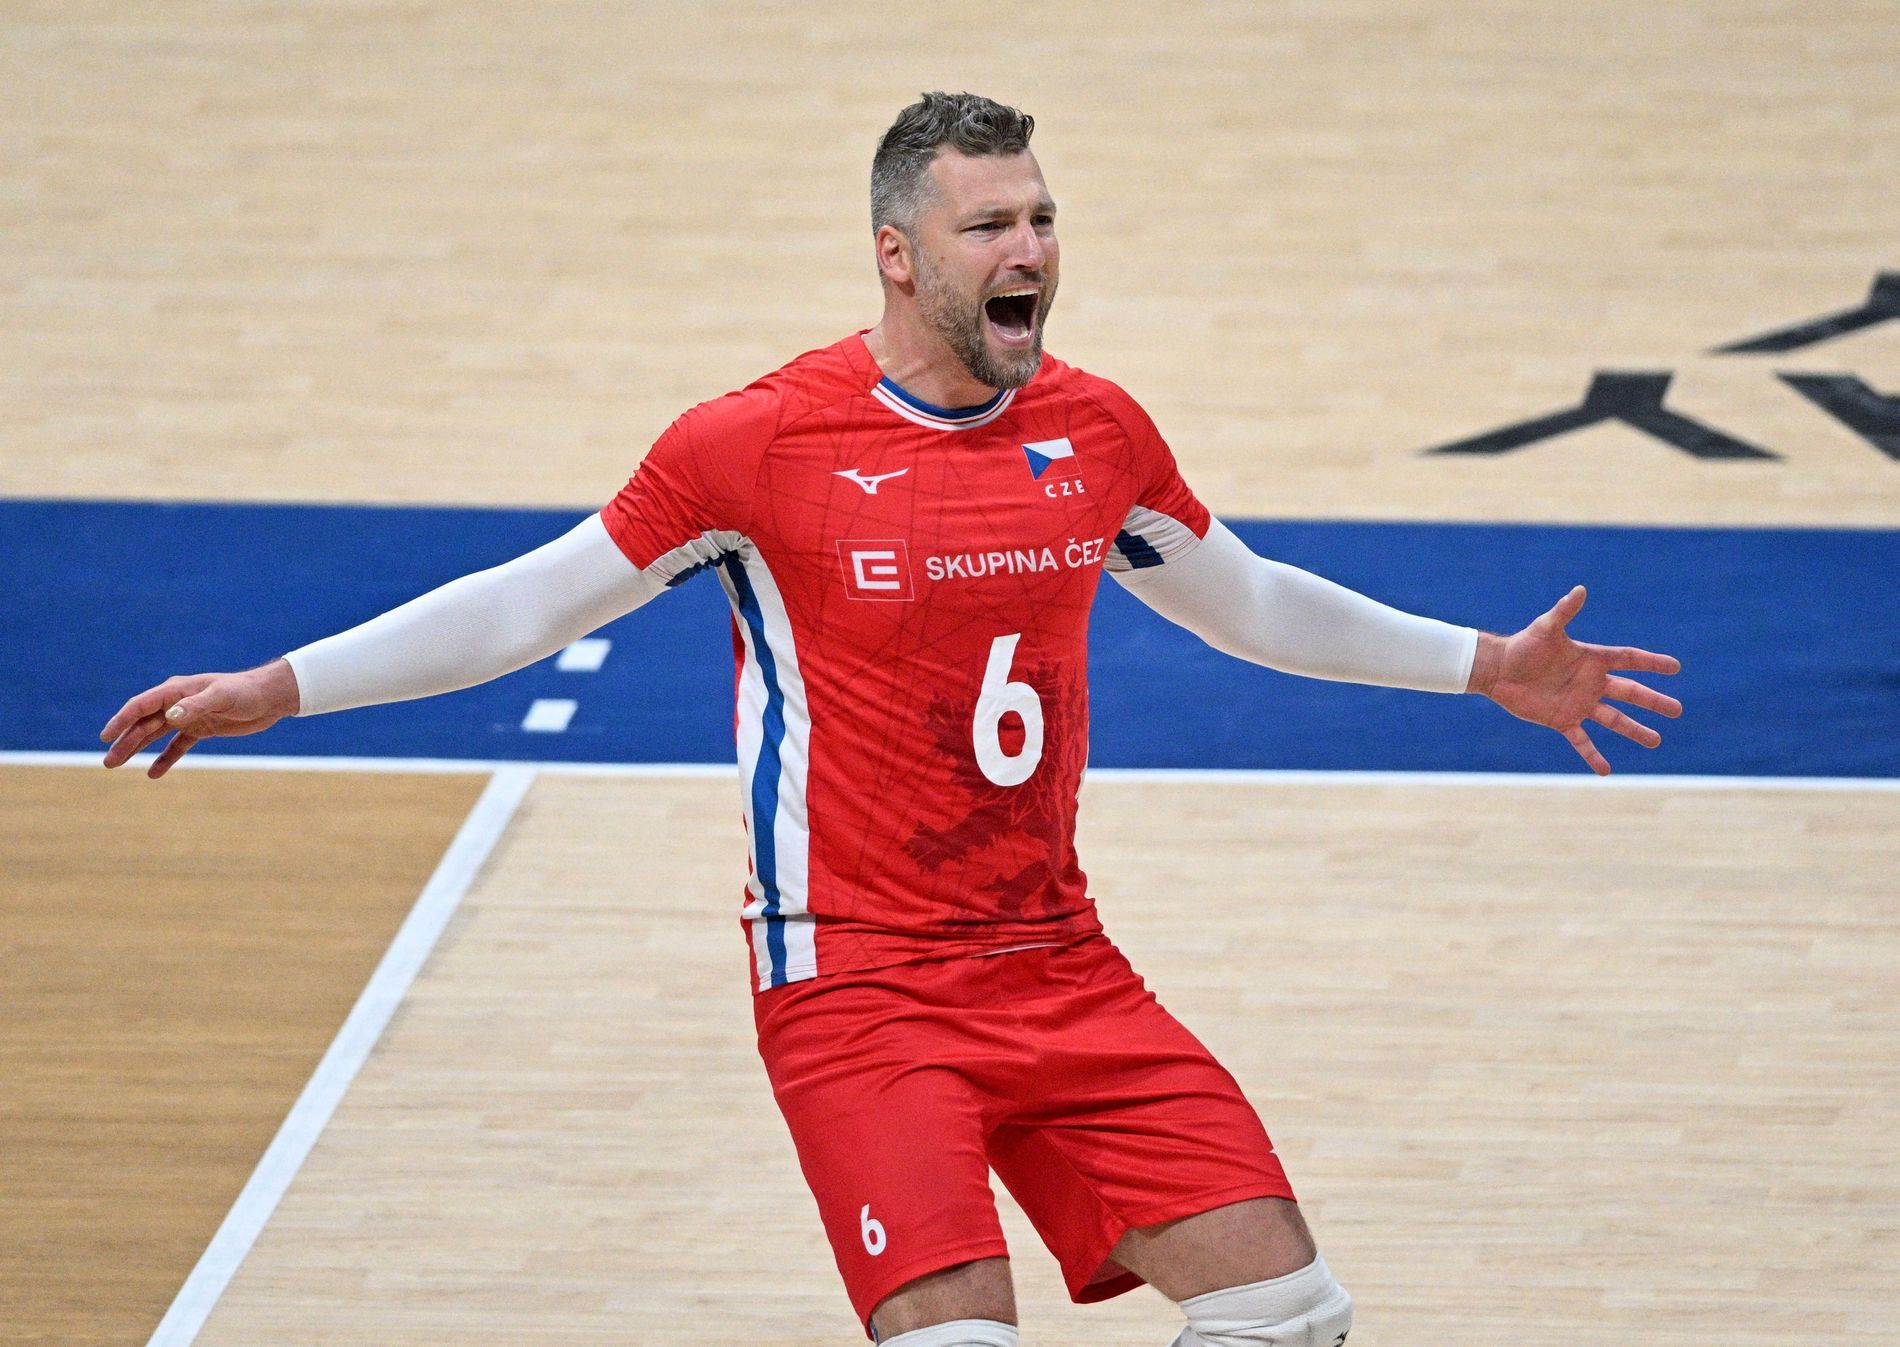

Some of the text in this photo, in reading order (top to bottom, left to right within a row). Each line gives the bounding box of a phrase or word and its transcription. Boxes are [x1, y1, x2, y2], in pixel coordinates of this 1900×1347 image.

[1044, 479, 1085, 498] CZE
[925, 537, 1105, 581] SKUPINA ČEZ
[972, 632, 1045, 787] 6
[860, 1203, 887, 1256] 6
